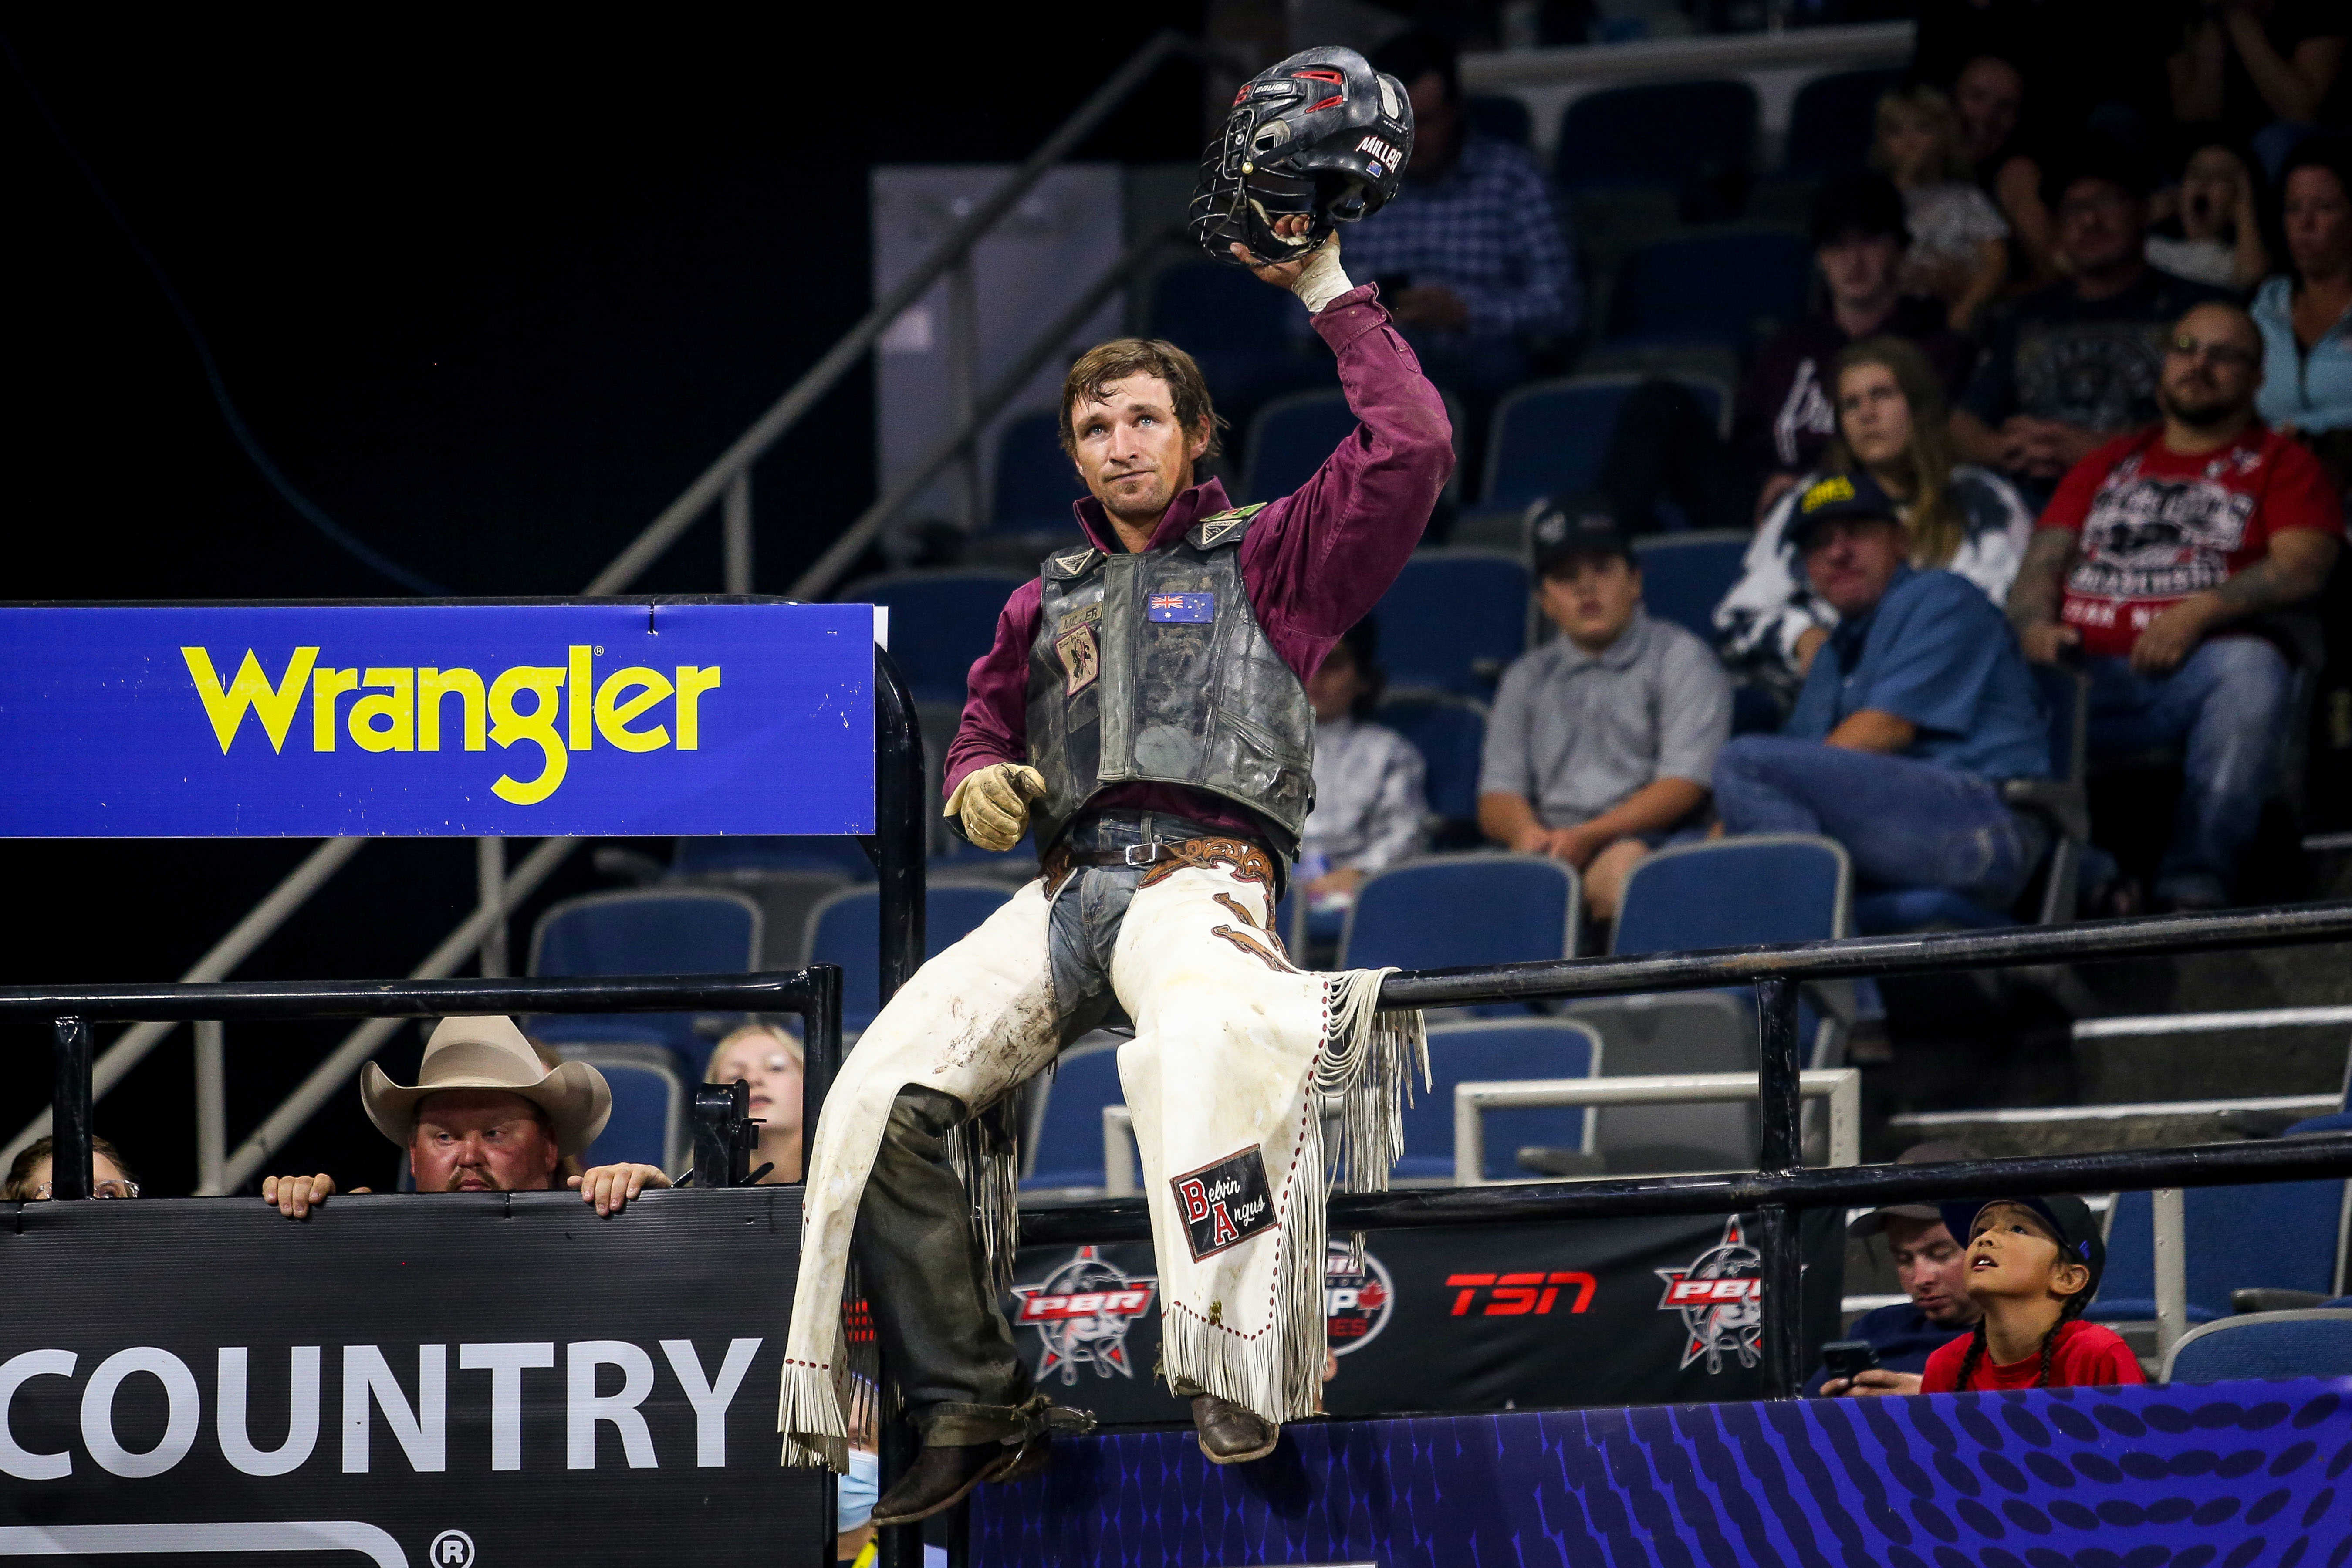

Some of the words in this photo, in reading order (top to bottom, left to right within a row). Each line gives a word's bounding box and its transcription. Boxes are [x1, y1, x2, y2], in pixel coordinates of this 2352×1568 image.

[179, 645, 720, 805] Wrangler
[1179, 1176, 1240, 1225] Belvin
[1212, 1194, 1266, 1247] Angus
[1028, 1292, 1145, 1315] PBR
[1445, 1271, 1598, 1316] TSN
[0, 1338, 763, 1480] COUNTRY
